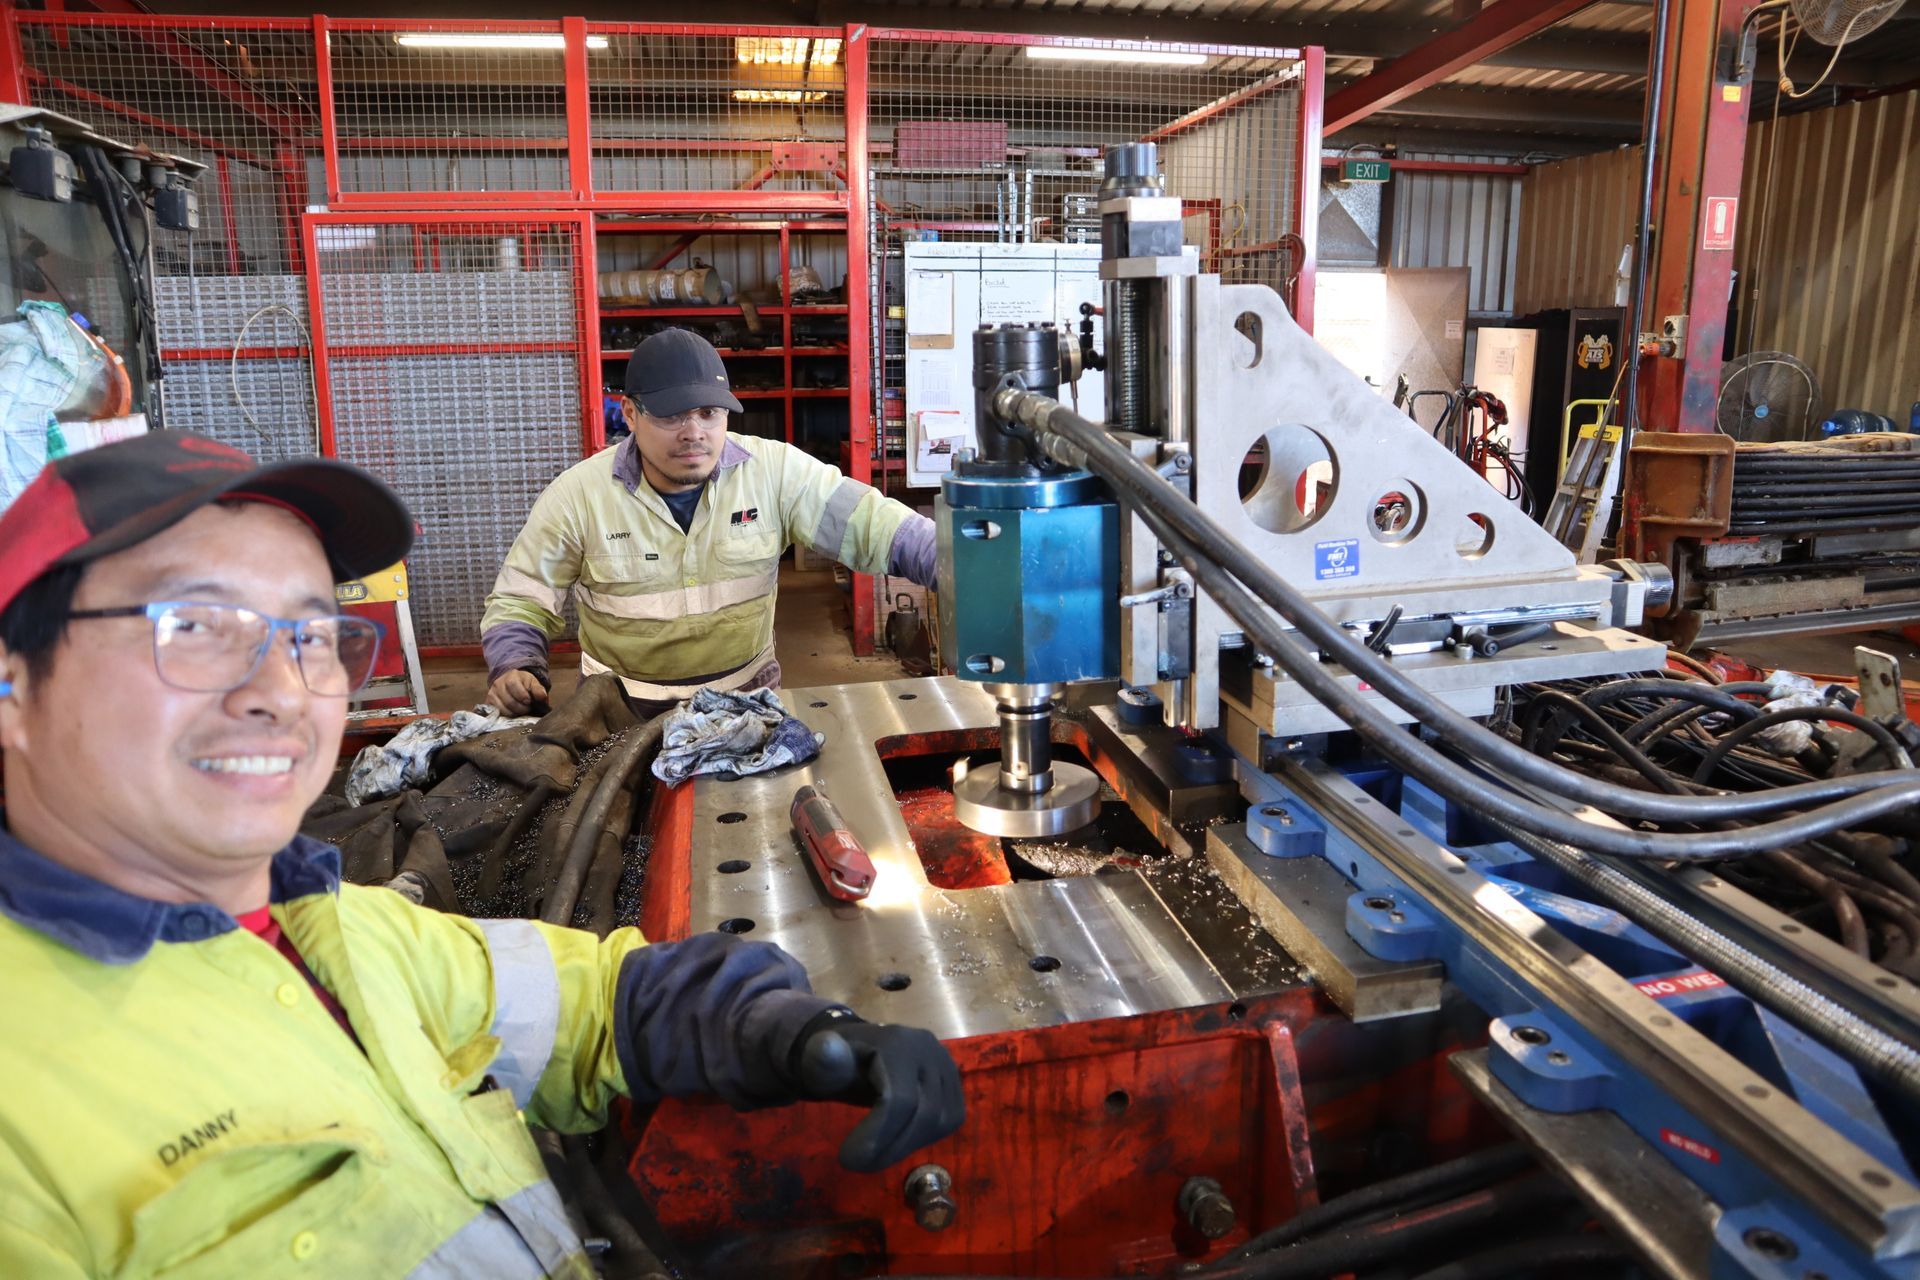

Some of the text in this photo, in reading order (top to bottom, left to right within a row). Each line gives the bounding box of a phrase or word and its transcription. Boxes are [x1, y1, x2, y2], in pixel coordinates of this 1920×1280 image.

[1356, 163, 1381, 179] EXIT
[606, 532, 631, 541] LARRY
[1639, 973, 1725, 996] NO WE
[157, 1108, 239, 1167] DANNY
